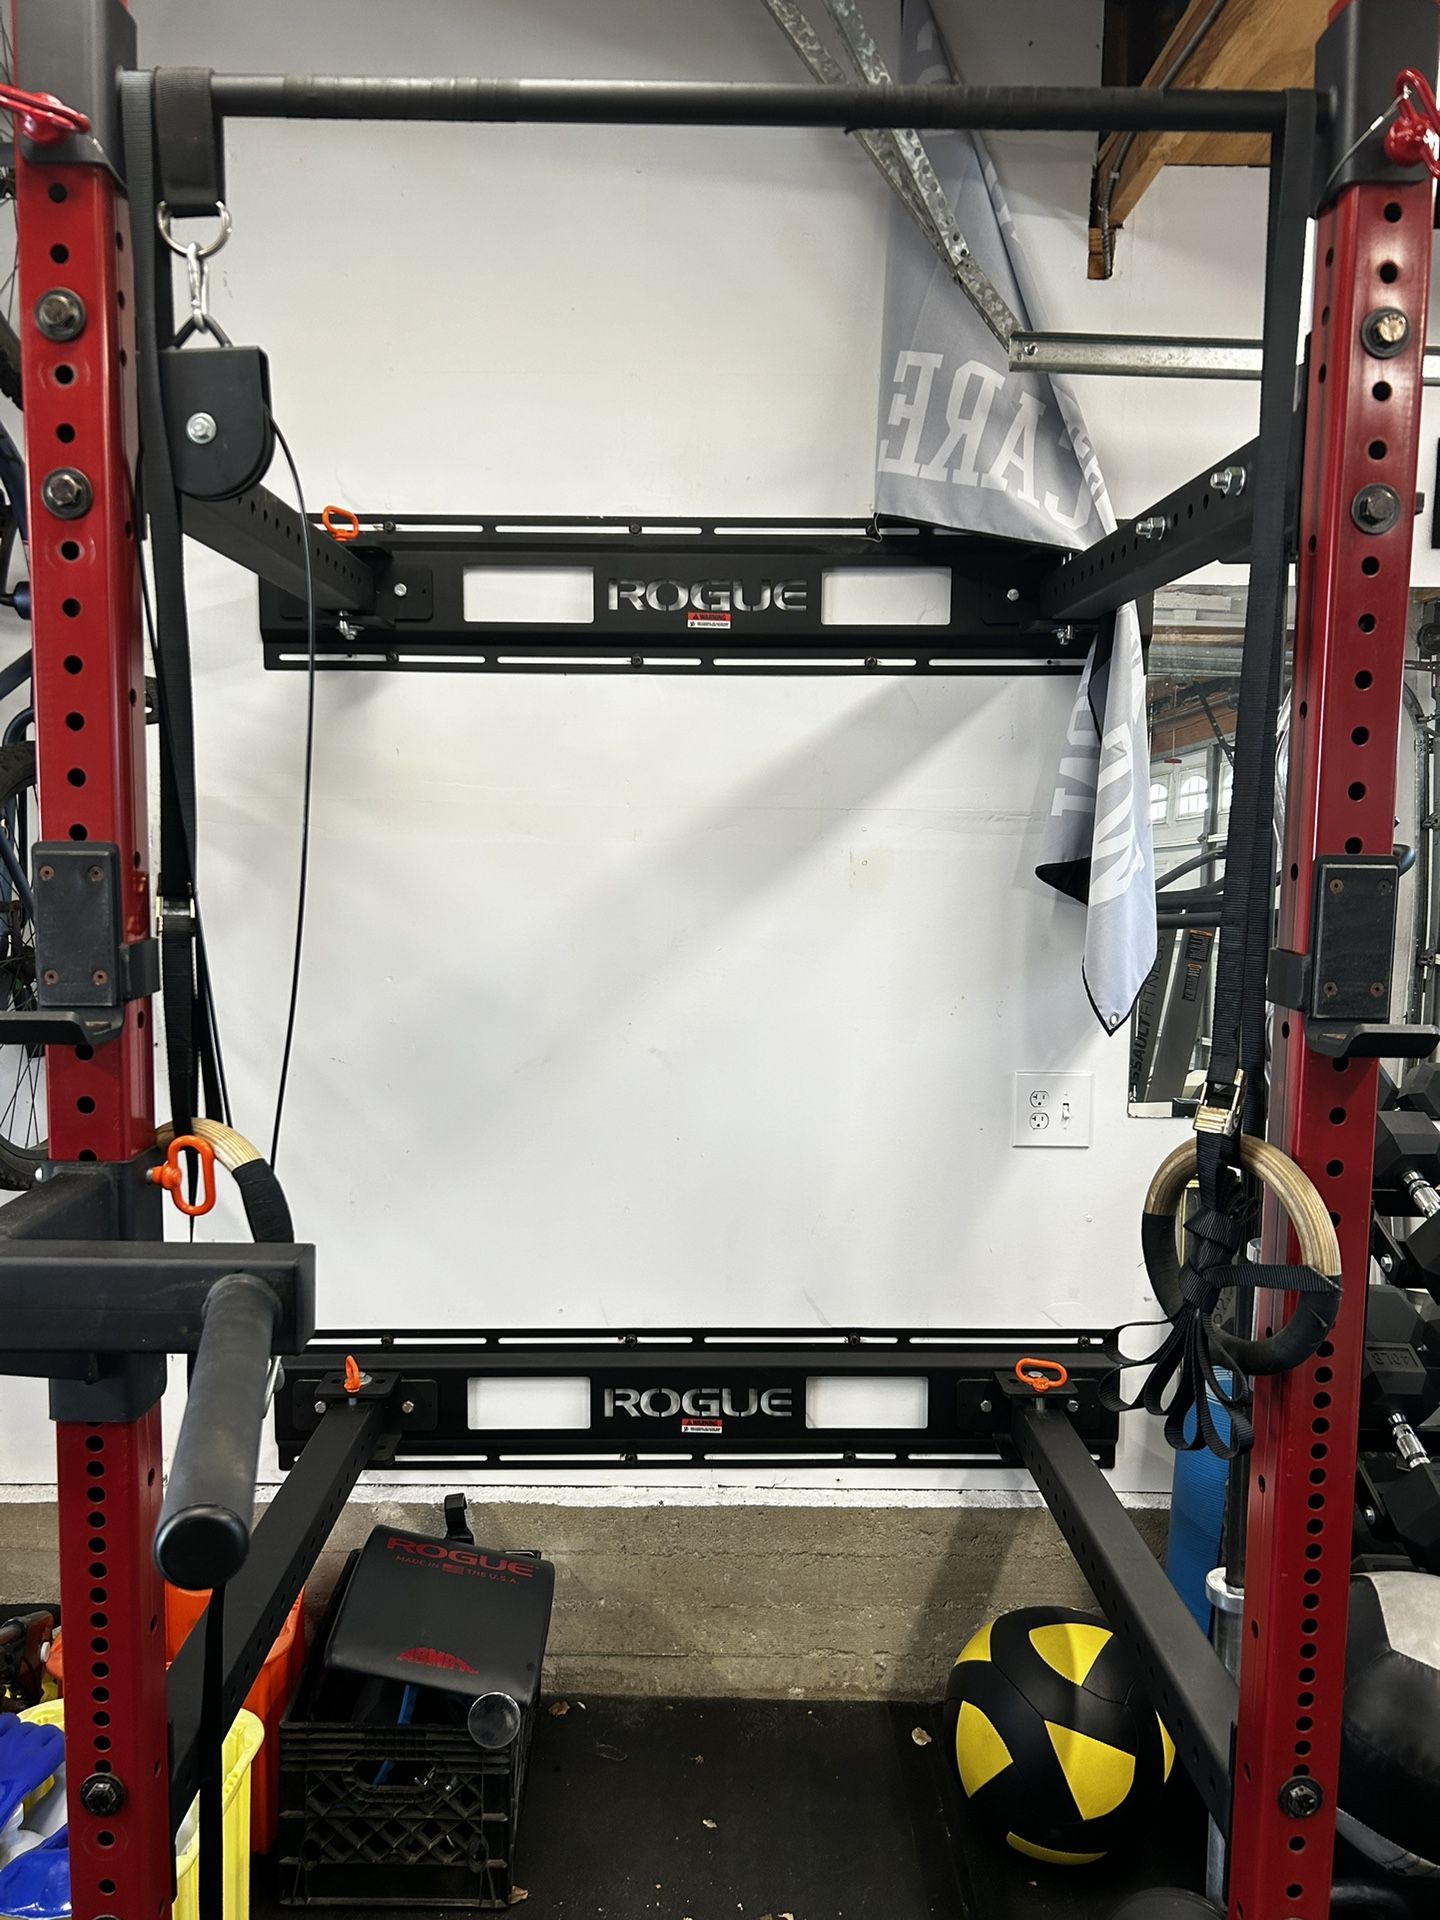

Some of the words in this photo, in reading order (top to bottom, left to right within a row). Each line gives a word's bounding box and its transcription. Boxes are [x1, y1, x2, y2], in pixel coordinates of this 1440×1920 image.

[608, 579, 807, 612] ROGUE
[604, 1388, 792, 1417] ROGUE
[386, 1536, 534, 1578] ROGUE
[395, 1554, 426, 1568] MADE
[467, 1568, 488, 1578] THE
